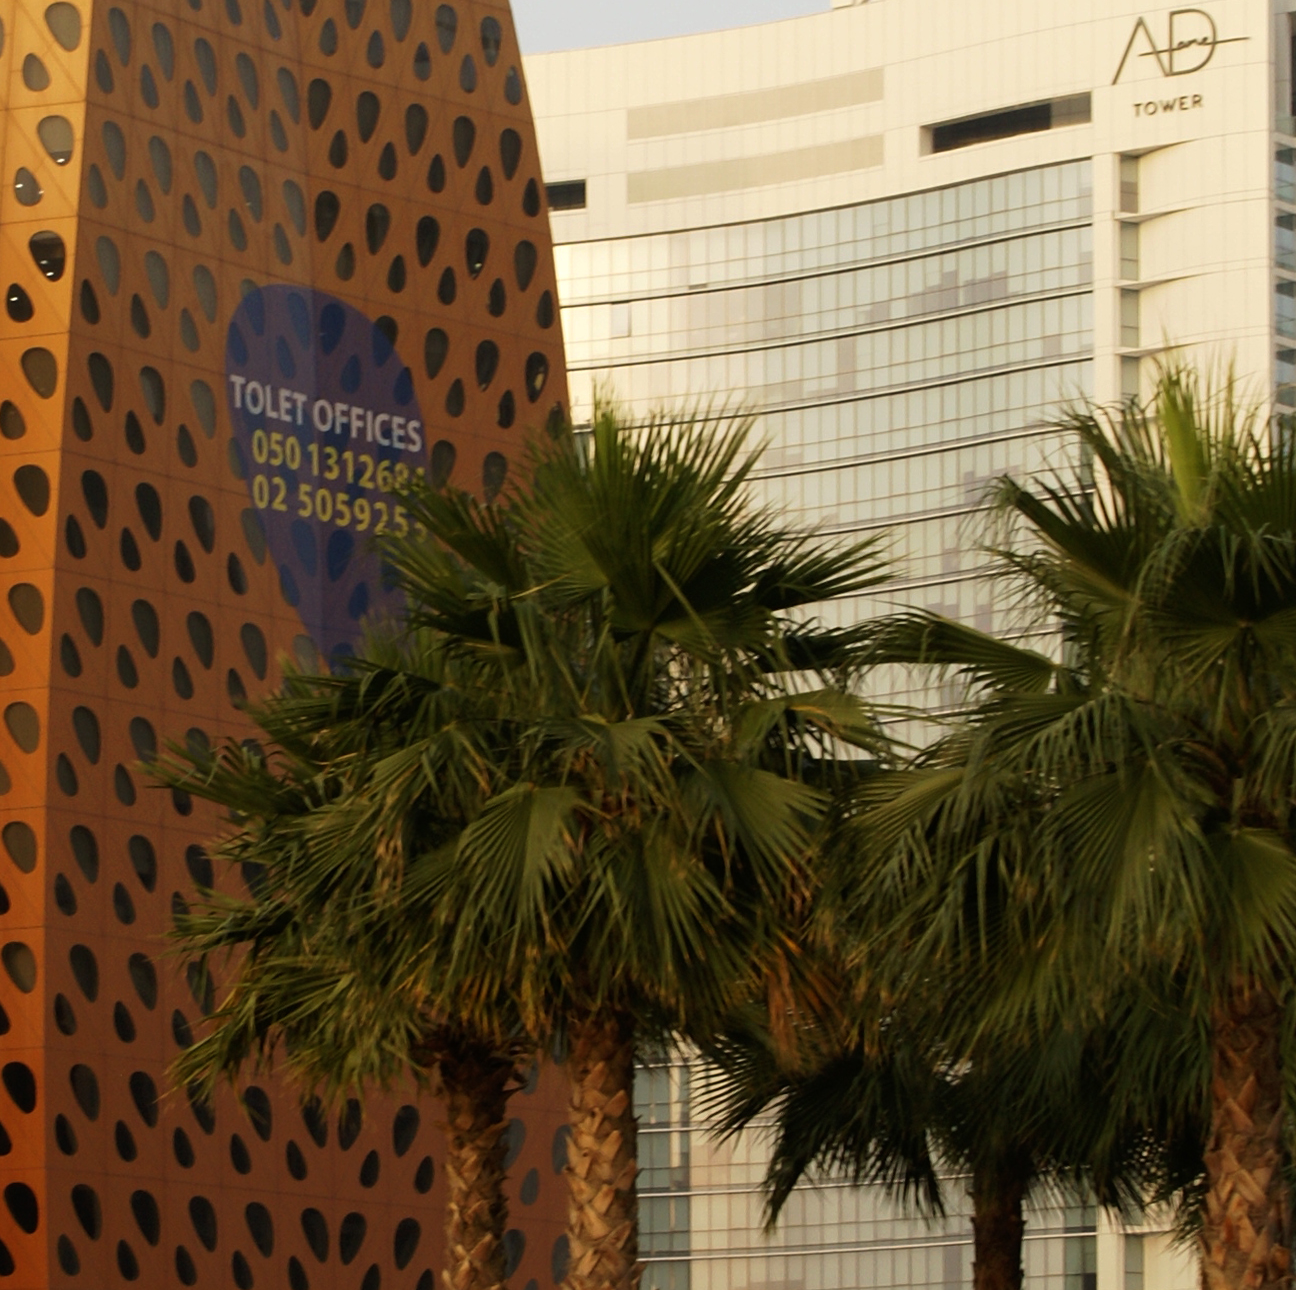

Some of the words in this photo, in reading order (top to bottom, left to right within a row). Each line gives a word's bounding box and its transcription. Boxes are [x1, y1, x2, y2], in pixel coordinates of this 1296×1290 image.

[1111, 8, 1217, 86] AD
[1133, 93, 1204, 118] TOWER
[229, 374, 307, 425] TOLET
[312, 399, 422, 452] OFFICES
[253, 429, 302, 470] 050
[253, 474, 288, 512] 02
